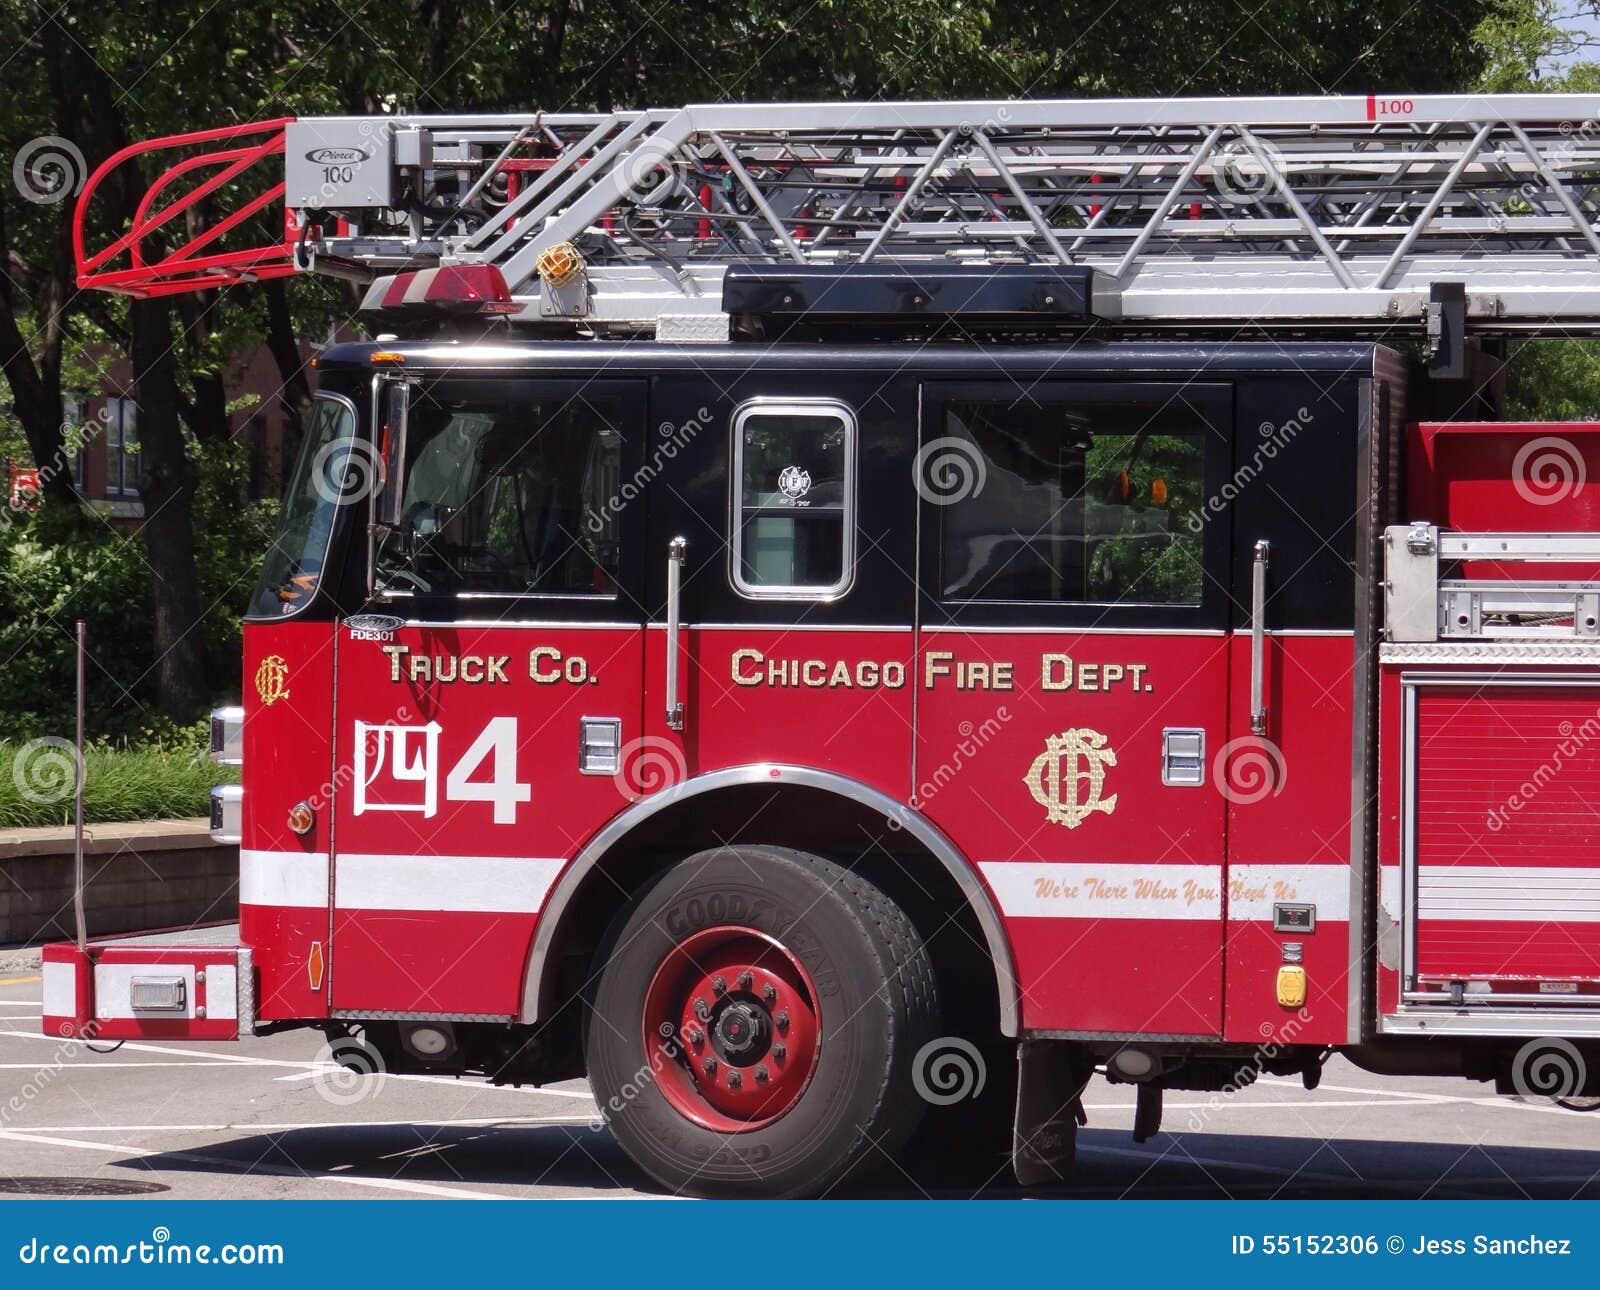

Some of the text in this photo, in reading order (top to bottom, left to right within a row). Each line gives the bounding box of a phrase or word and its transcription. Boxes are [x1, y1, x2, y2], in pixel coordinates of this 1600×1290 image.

[1379, 100, 1414, 114] 100
[318, 149, 356, 161] Pierce
[321, 166, 353, 184] 100
[350, 630, 395, 642] FDE301
[353, 719, 443, 819] 四
[446, 717, 531, 825] 4
[1034, 877, 1079, 899] We're
[1083, 877, 1128, 900] There
[1133, 878, 1178, 900] When
[1183, 879, 1216, 907] You
[1273, 880, 1297, 900] Us
